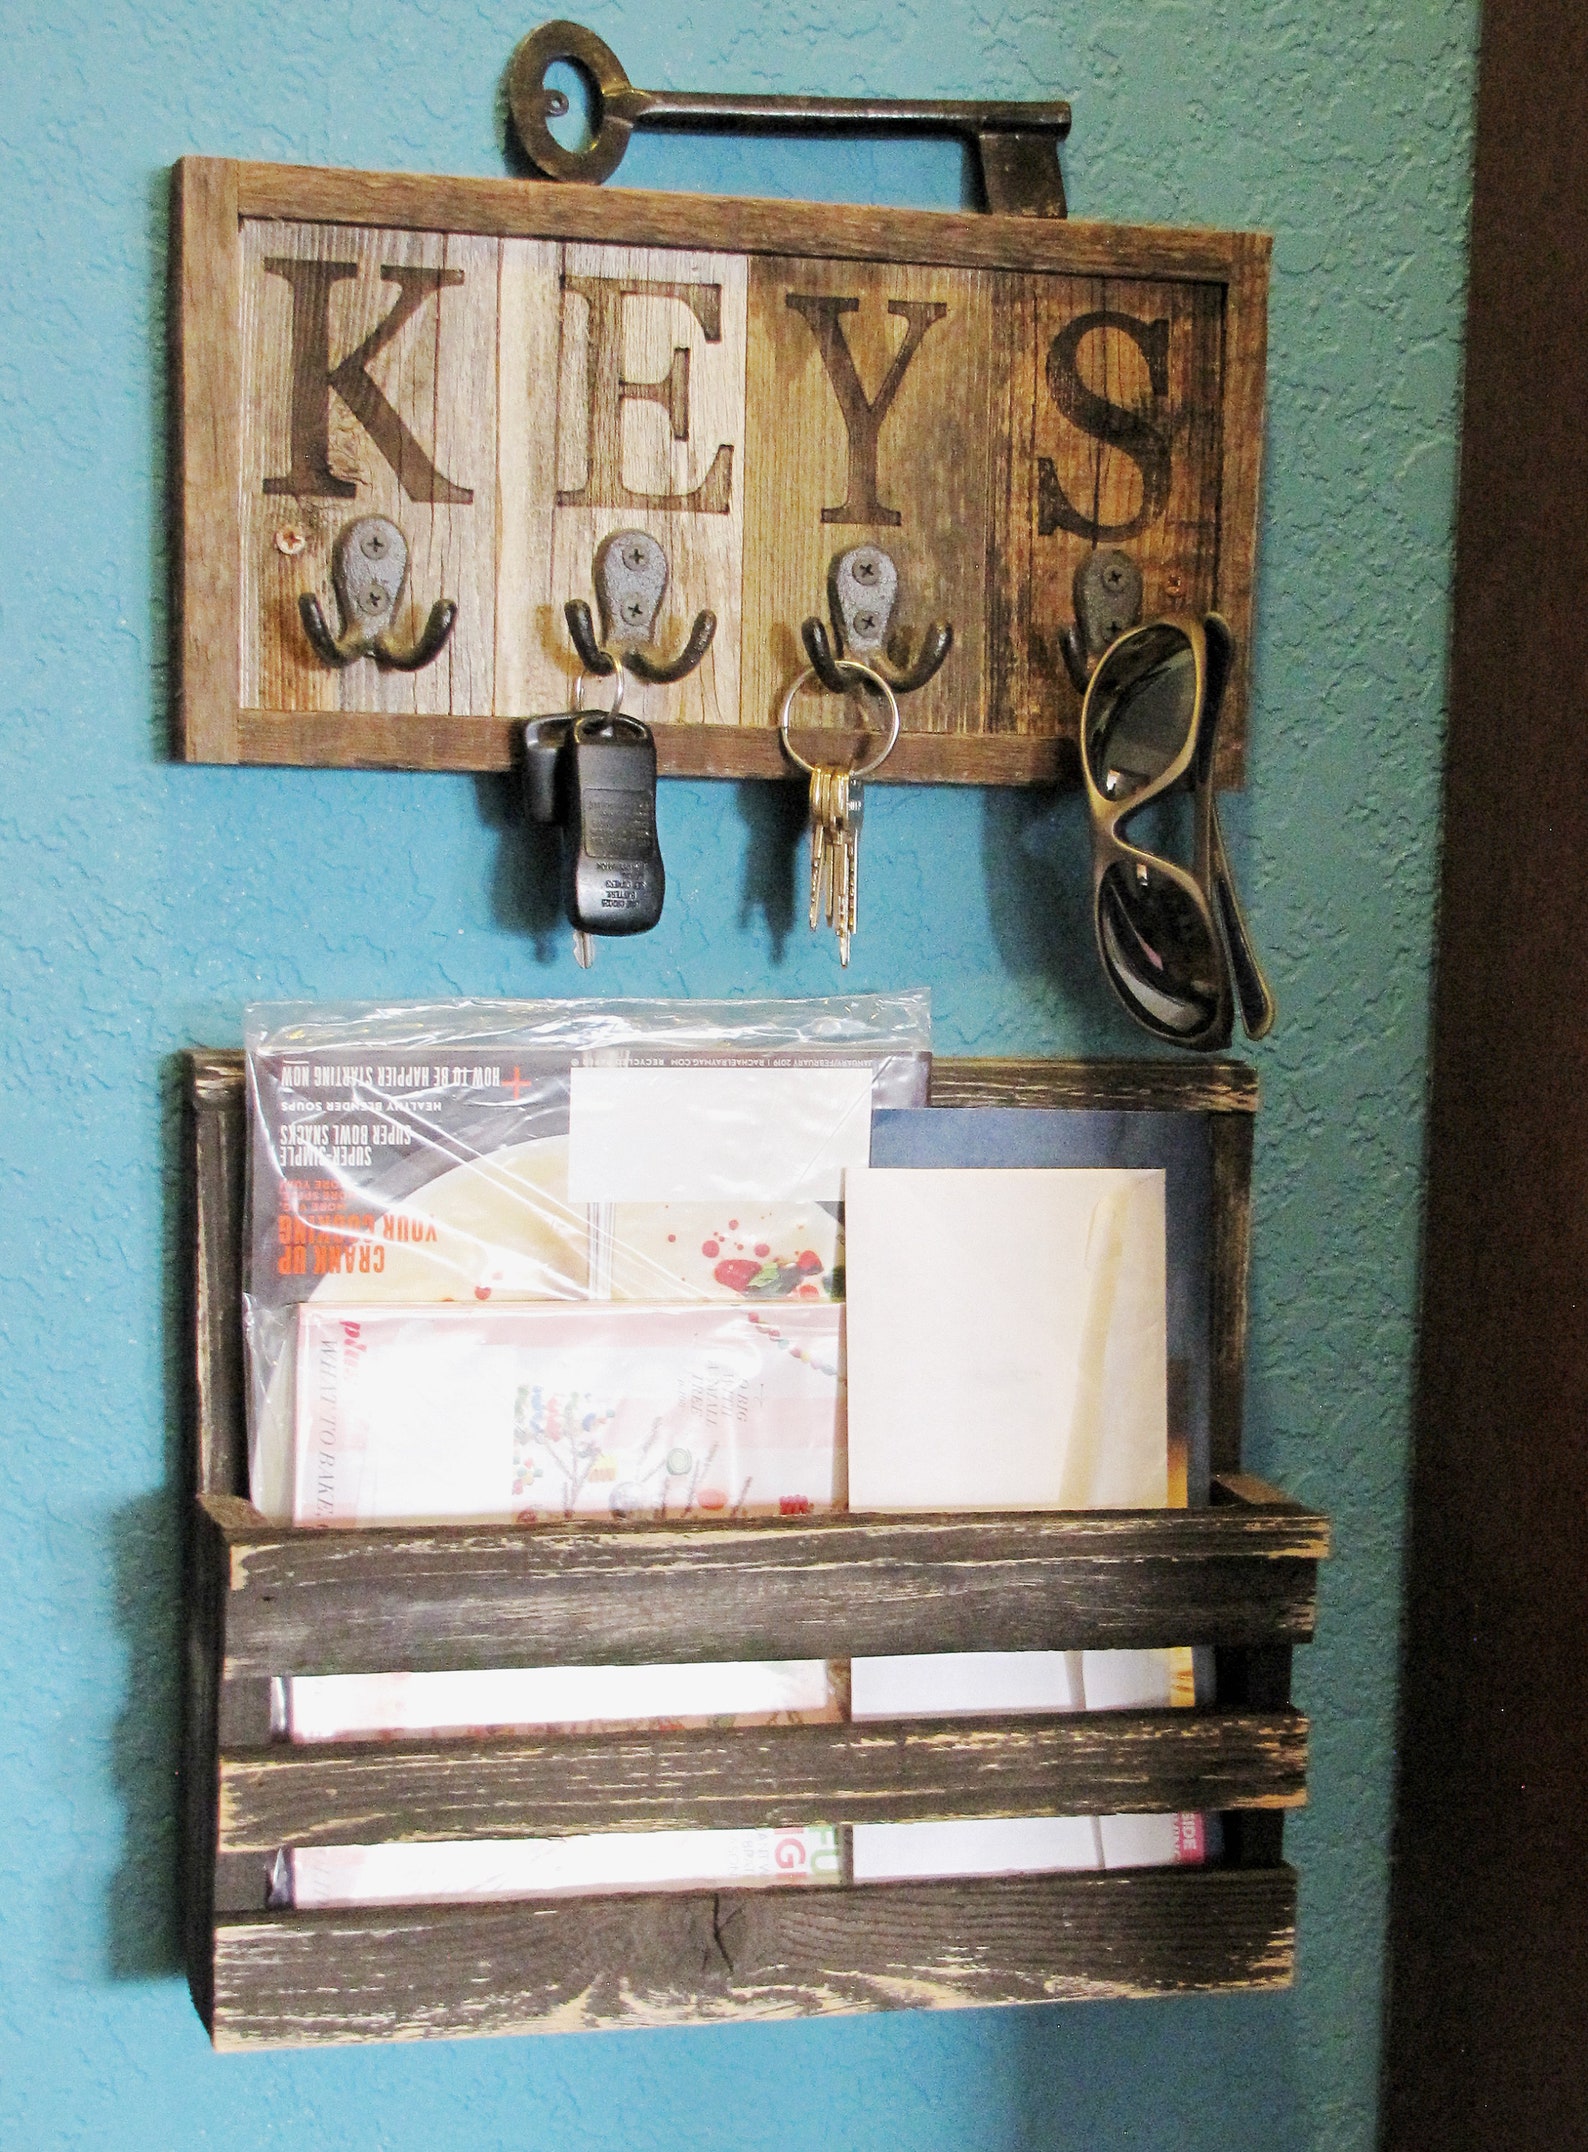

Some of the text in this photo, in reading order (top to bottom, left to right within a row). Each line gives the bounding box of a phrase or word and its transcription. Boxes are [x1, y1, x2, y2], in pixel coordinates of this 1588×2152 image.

[262, 256, 1172, 543] KEYS
[281, 1065, 501, 1088] HOW TO BE HAPPIER STARTING NOW
[670, 1057, 872, 1068] JANUARY/FEBRUARY 2019 RACHAELRAYMAG.COM
[281, 1100, 323, 1112] SOUPS
[279, 1124, 412, 1146] SUPER BOWL SNACKS
[383, 1213, 438, 1243] YOUR
[277, 1244, 386, 1275] CRANK UP
[319, 1338, 339, 1409] WHAT
[736, 1393, 750, 1424] BIG
[319, 1415, 337, 1446] TO
